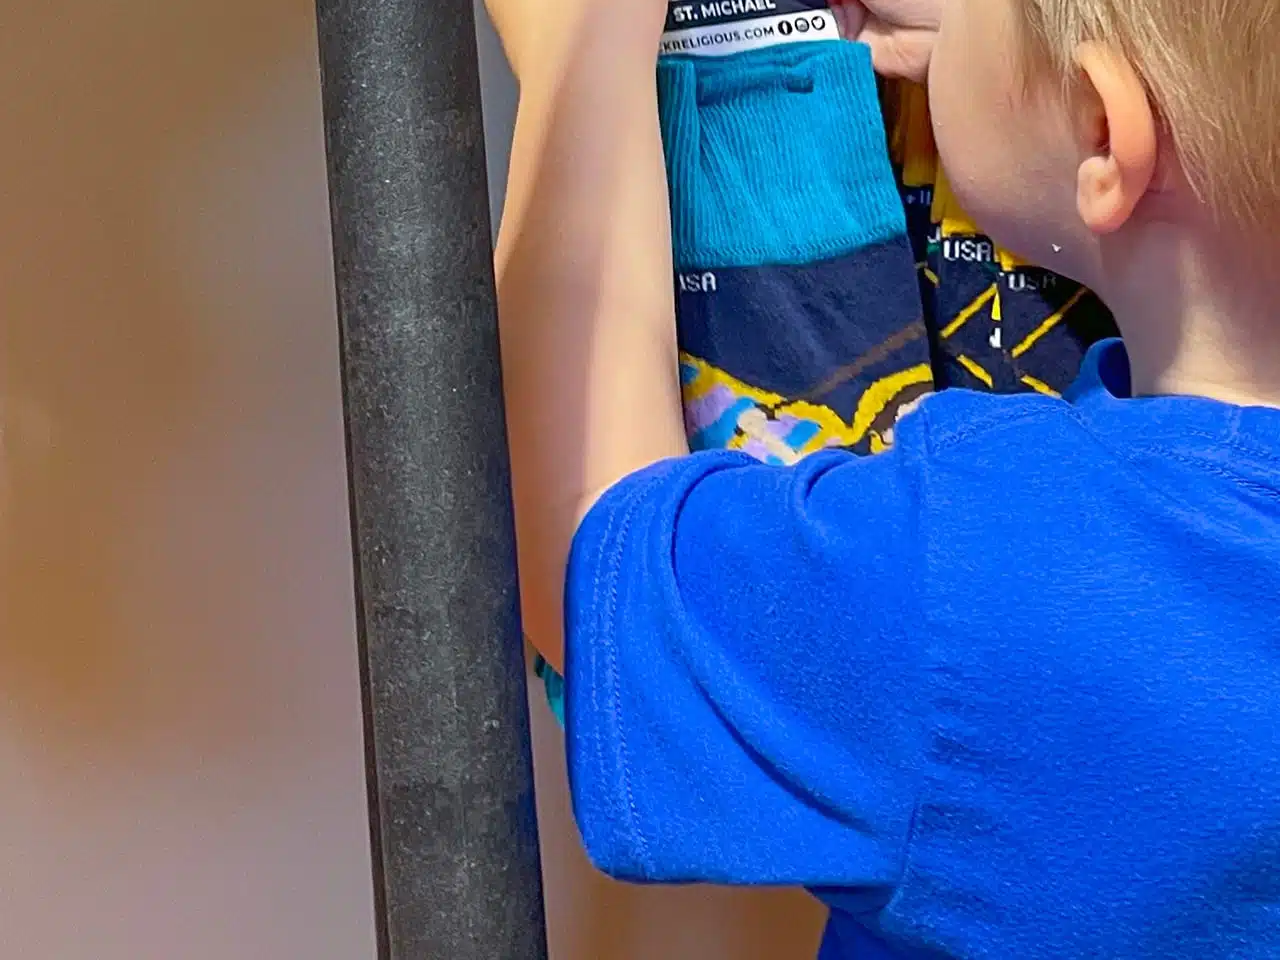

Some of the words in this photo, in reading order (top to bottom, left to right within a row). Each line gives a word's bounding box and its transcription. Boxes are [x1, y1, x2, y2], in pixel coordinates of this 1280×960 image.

[674, 6, 698, 22] ST.
[660, 26, 775, 52] KRELIGIOUS.COM
[943, 239, 993, 262] USA
